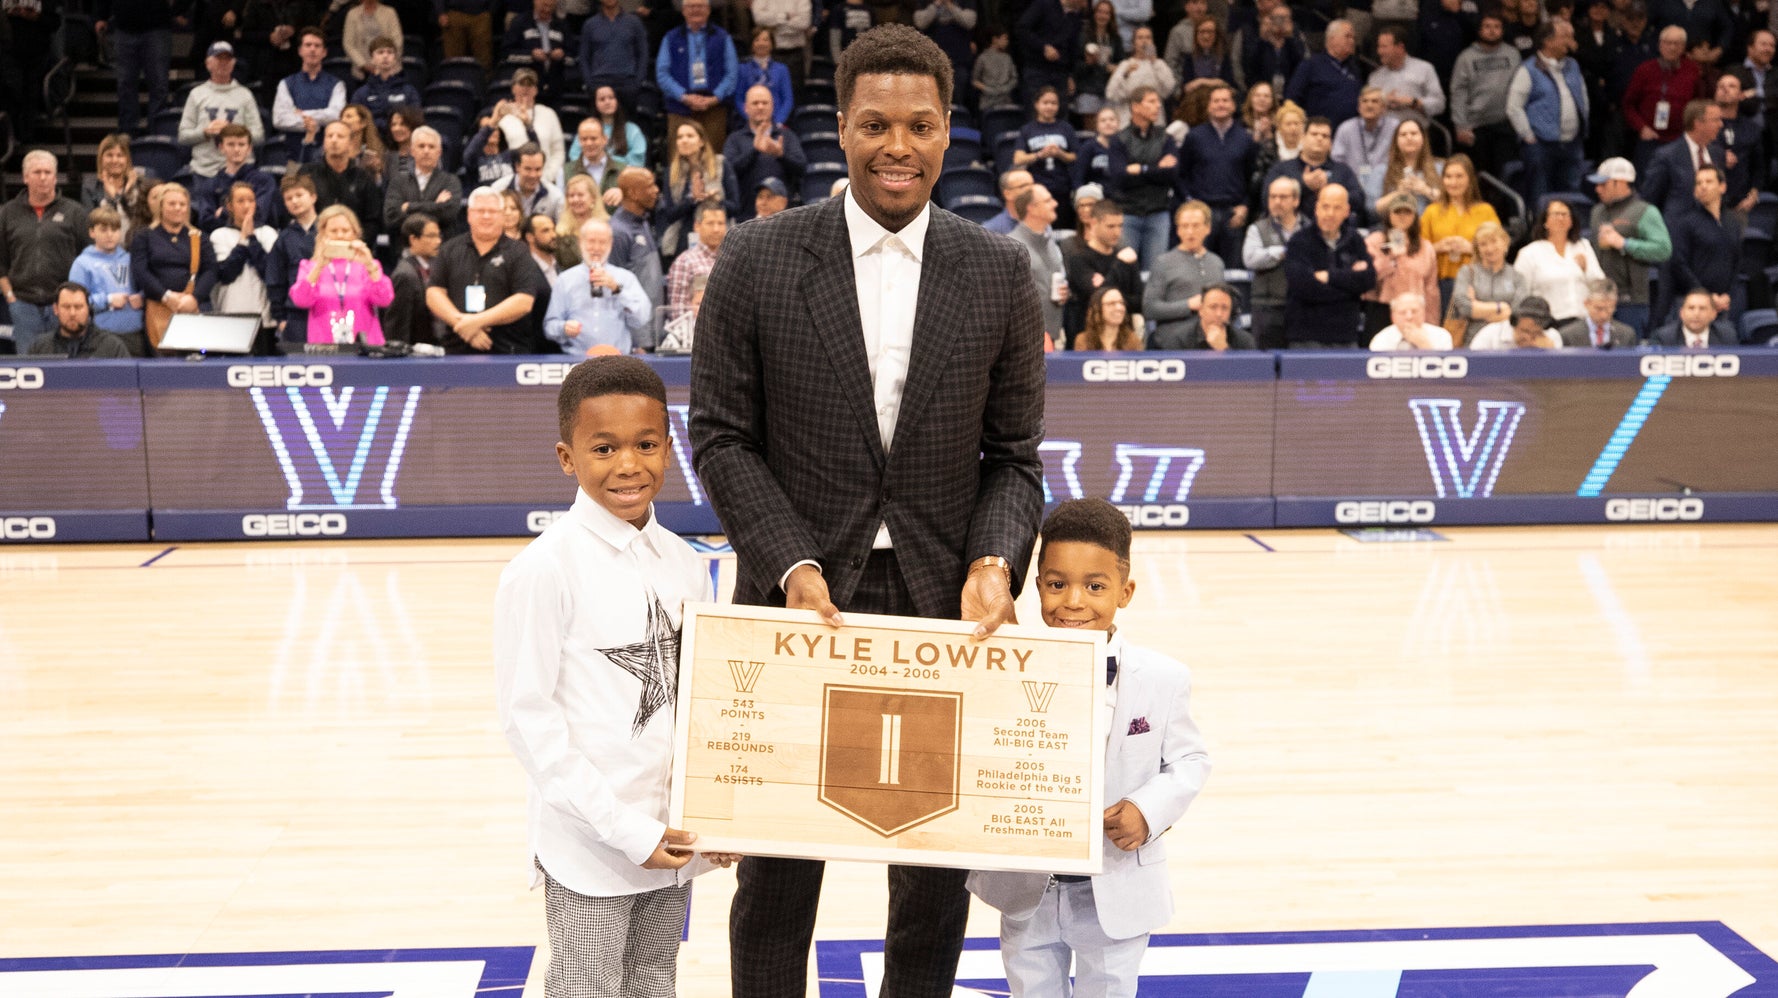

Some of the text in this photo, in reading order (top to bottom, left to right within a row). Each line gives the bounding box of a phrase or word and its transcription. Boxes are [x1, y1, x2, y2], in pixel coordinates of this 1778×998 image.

[1083, 359, 1186, 382] GEICO
[1366, 356, 1468, 379] GEICO
[1640, 354, 1740, 377] GEICO
[227, 365, 333, 387] GEICO
[516, 363, 582, 385] GEI
[1114, 504, 1190, 527] ICO
[1335, 500, 1436, 523] GEICO
[1605, 498, 1704, 521] GEICO
[0, 517, 56, 539] ICO
[242, 513, 348, 536] GEICO
[774, 631, 1034, 673] KYLE LOWRY
[850, 664, 887, 677] 2004
[903, 667, 941, 680] 2006
[733, 699, 754, 709] 543
[721, 709, 765, 720] POINTS
[1016, 718, 1046, 728] 2006
[732, 732, 751, 742] 219
[993, 727, 1069, 740] Second Team
[707, 741, 774, 754] REBOUNDS
[993, 738, 1068, 750] All-BIG EAST
[730, 765, 749, 774] 174
[1015, 761, 1045, 771] 2005
[714, 775, 764, 786] ASSISTS
[977, 769, 1082, 784] Philadelphia Big 5
[976, 780, 1083, 795] Rookie of the Year
[1014, 804, 1044, 814] 2005
[991, 814, 1065, 827] BIG EAST All
[983, 824, 1073, 838] Freshman Team
